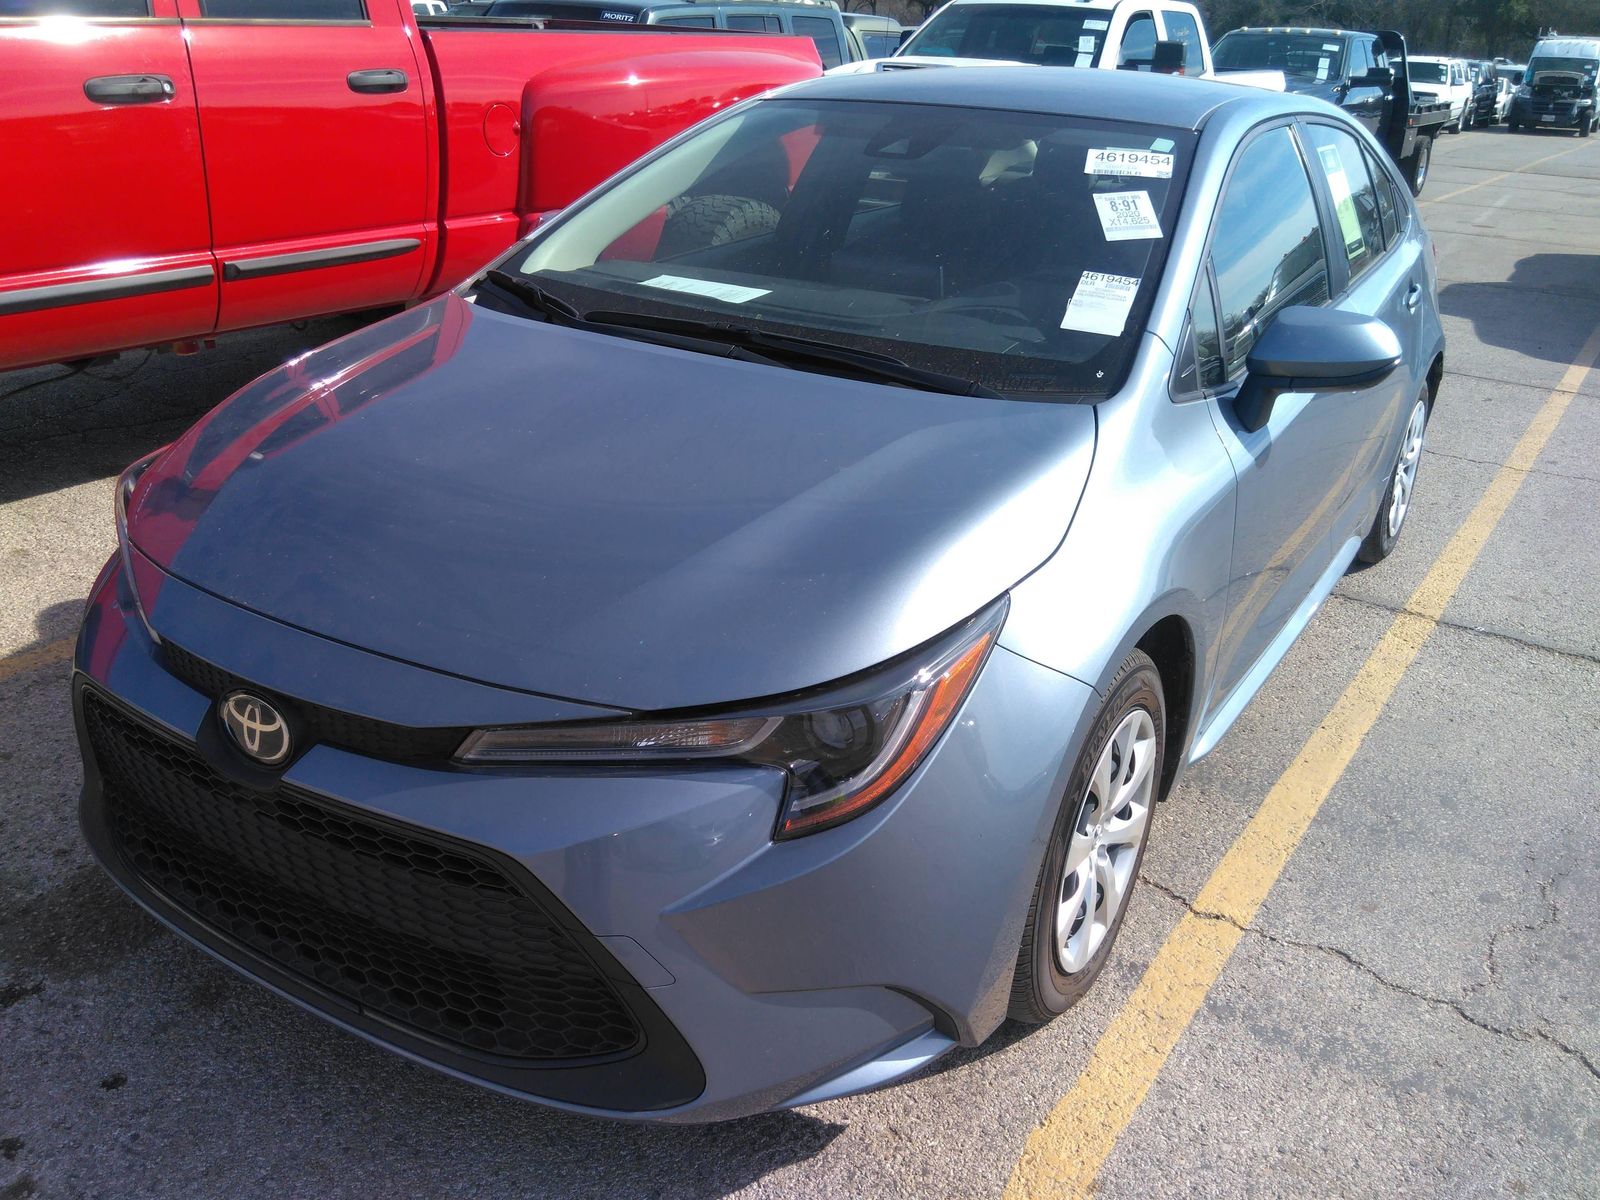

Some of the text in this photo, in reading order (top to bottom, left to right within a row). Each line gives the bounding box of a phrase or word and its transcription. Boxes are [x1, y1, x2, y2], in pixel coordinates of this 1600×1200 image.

[603, 12, 634, 22] MORITZ
[1095, 152, 1171, 165] 4619454
[1109, 199, 1139, 212] 8:91
[1115, 210, 1141, 219] 2020
[1082, 272, 1139, 287] 4619454
